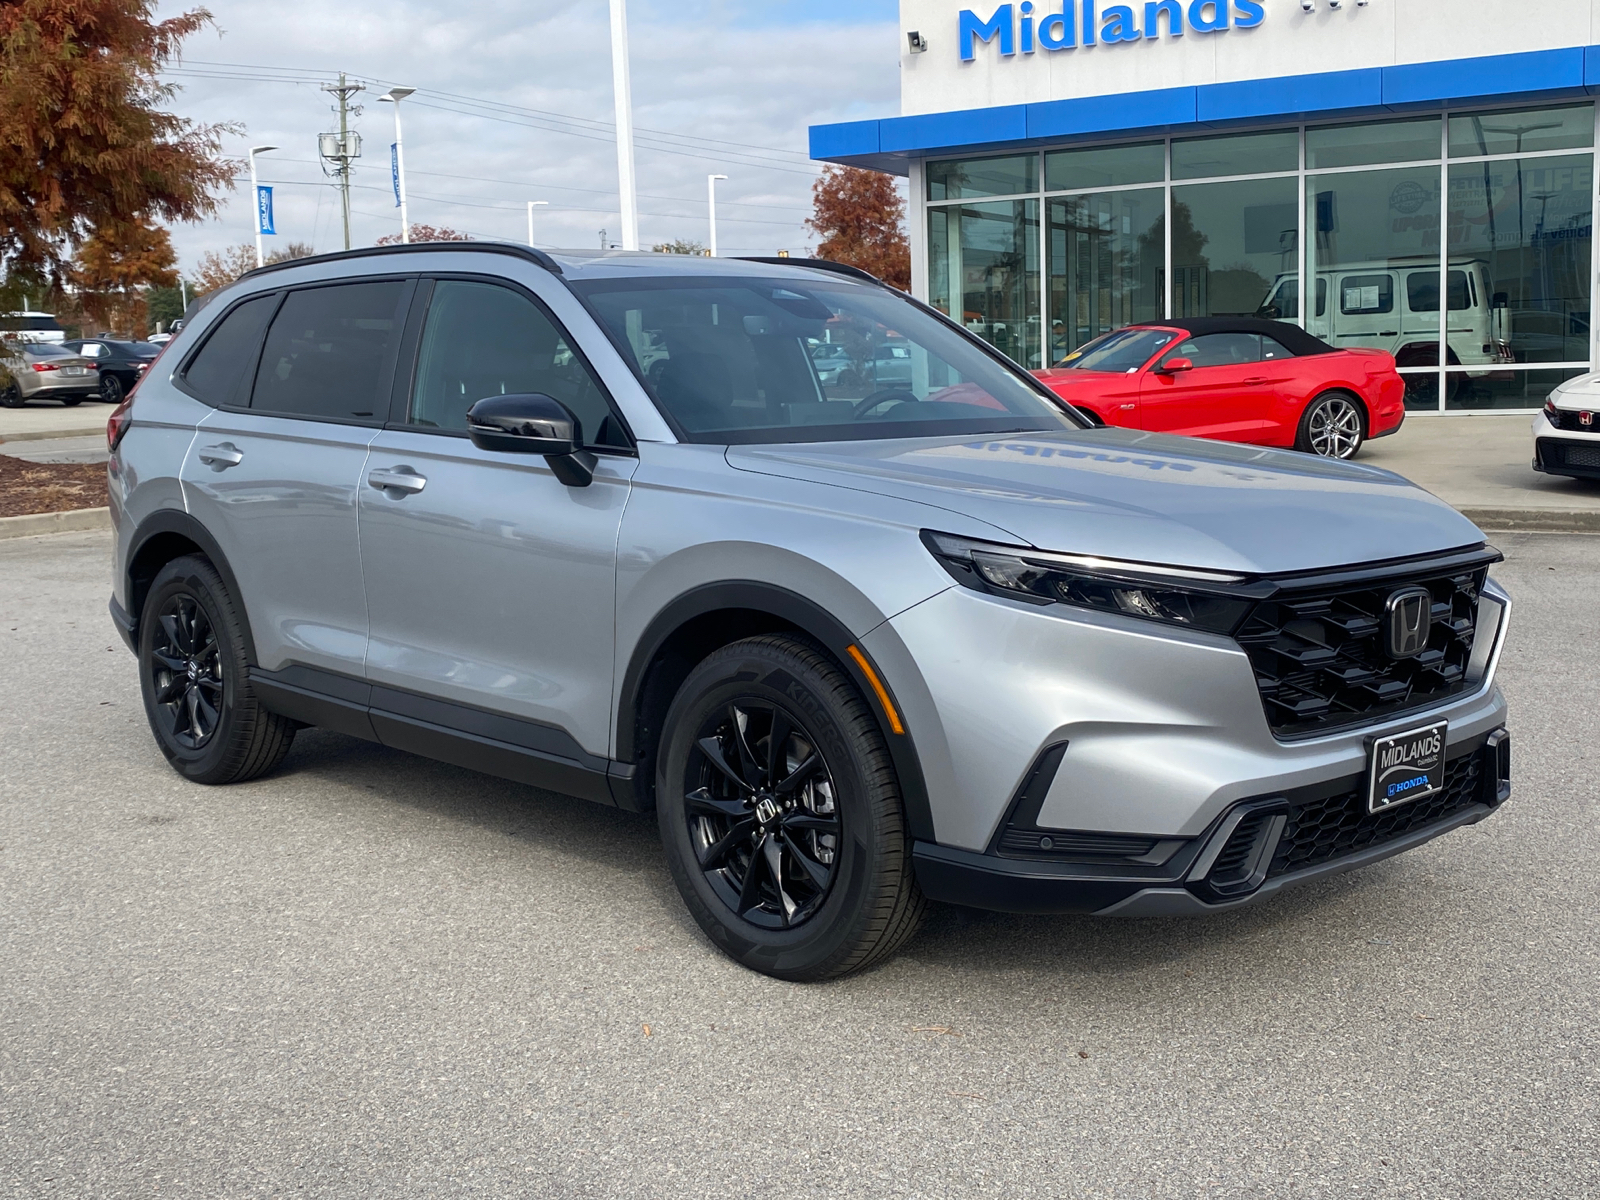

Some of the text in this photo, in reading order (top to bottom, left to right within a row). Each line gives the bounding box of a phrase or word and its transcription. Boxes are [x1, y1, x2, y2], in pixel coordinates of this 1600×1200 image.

[958, 0, 1266, 62] Midlands
[260, 189, 268, 230] MIDLANDS
[1380, 734, 1441, 769] MIDLANDS
[1396, 774, 1429, 793] HONDA
